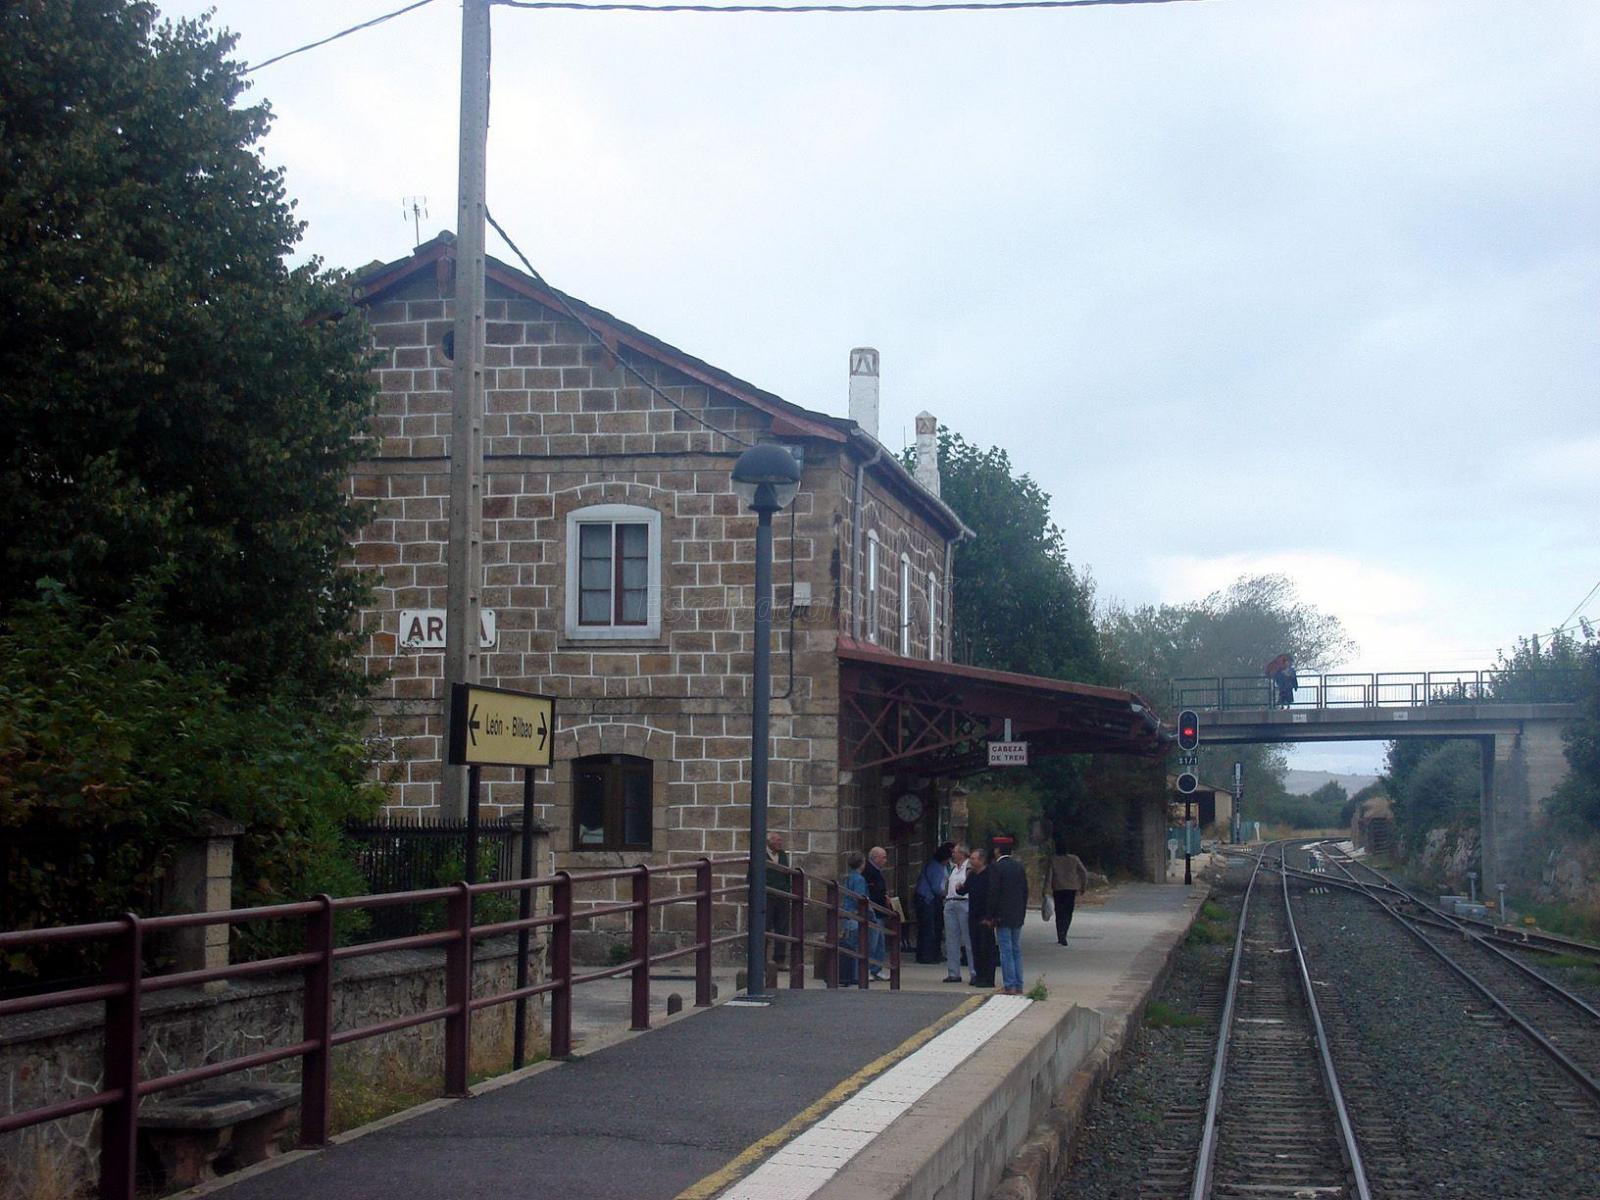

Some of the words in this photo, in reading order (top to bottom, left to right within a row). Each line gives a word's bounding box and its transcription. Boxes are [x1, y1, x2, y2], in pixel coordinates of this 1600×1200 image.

[485, 712, 503, 736] León
[512, 716, 533, 739] Bilbao
[991, 745, 1024, 753] CABEZA
[990, 754, 1001, 762] DE
[1004, 754, 1025, 762] TREN
